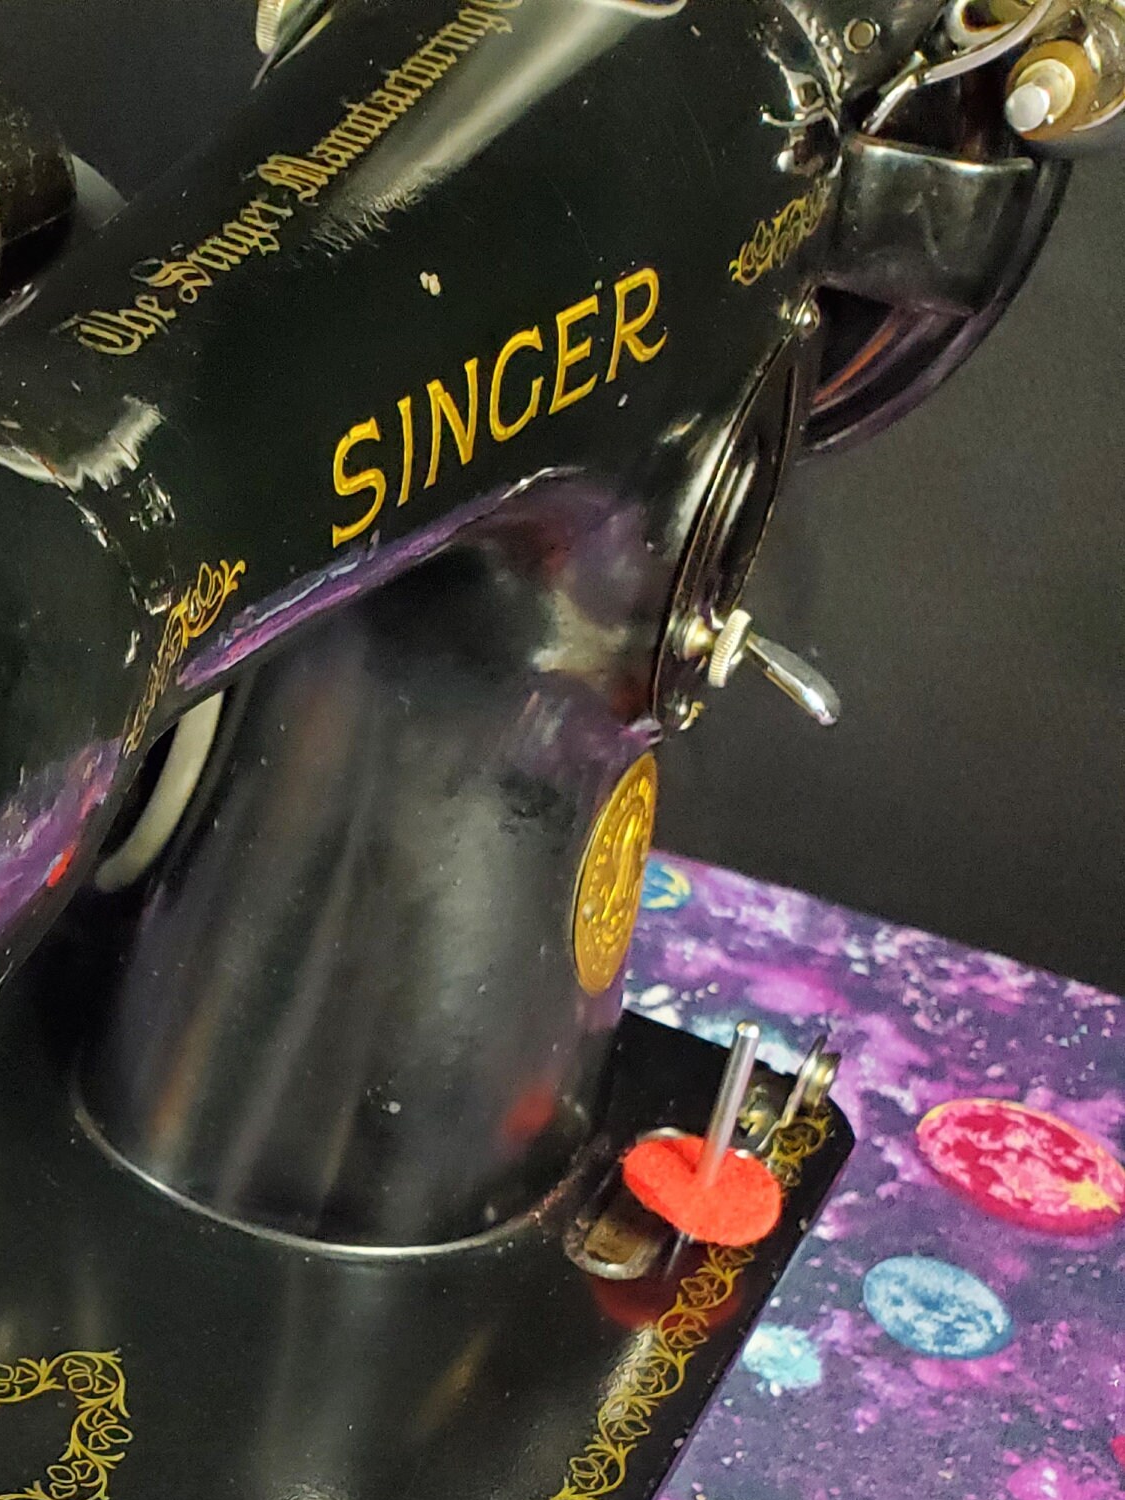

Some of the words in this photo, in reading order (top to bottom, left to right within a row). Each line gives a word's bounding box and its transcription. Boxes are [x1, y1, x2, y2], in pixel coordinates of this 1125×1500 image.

[53, 294, 176, 356] The
[130, 198, 294, 304] Singer
[331, 267, 668, 549] SINGER
